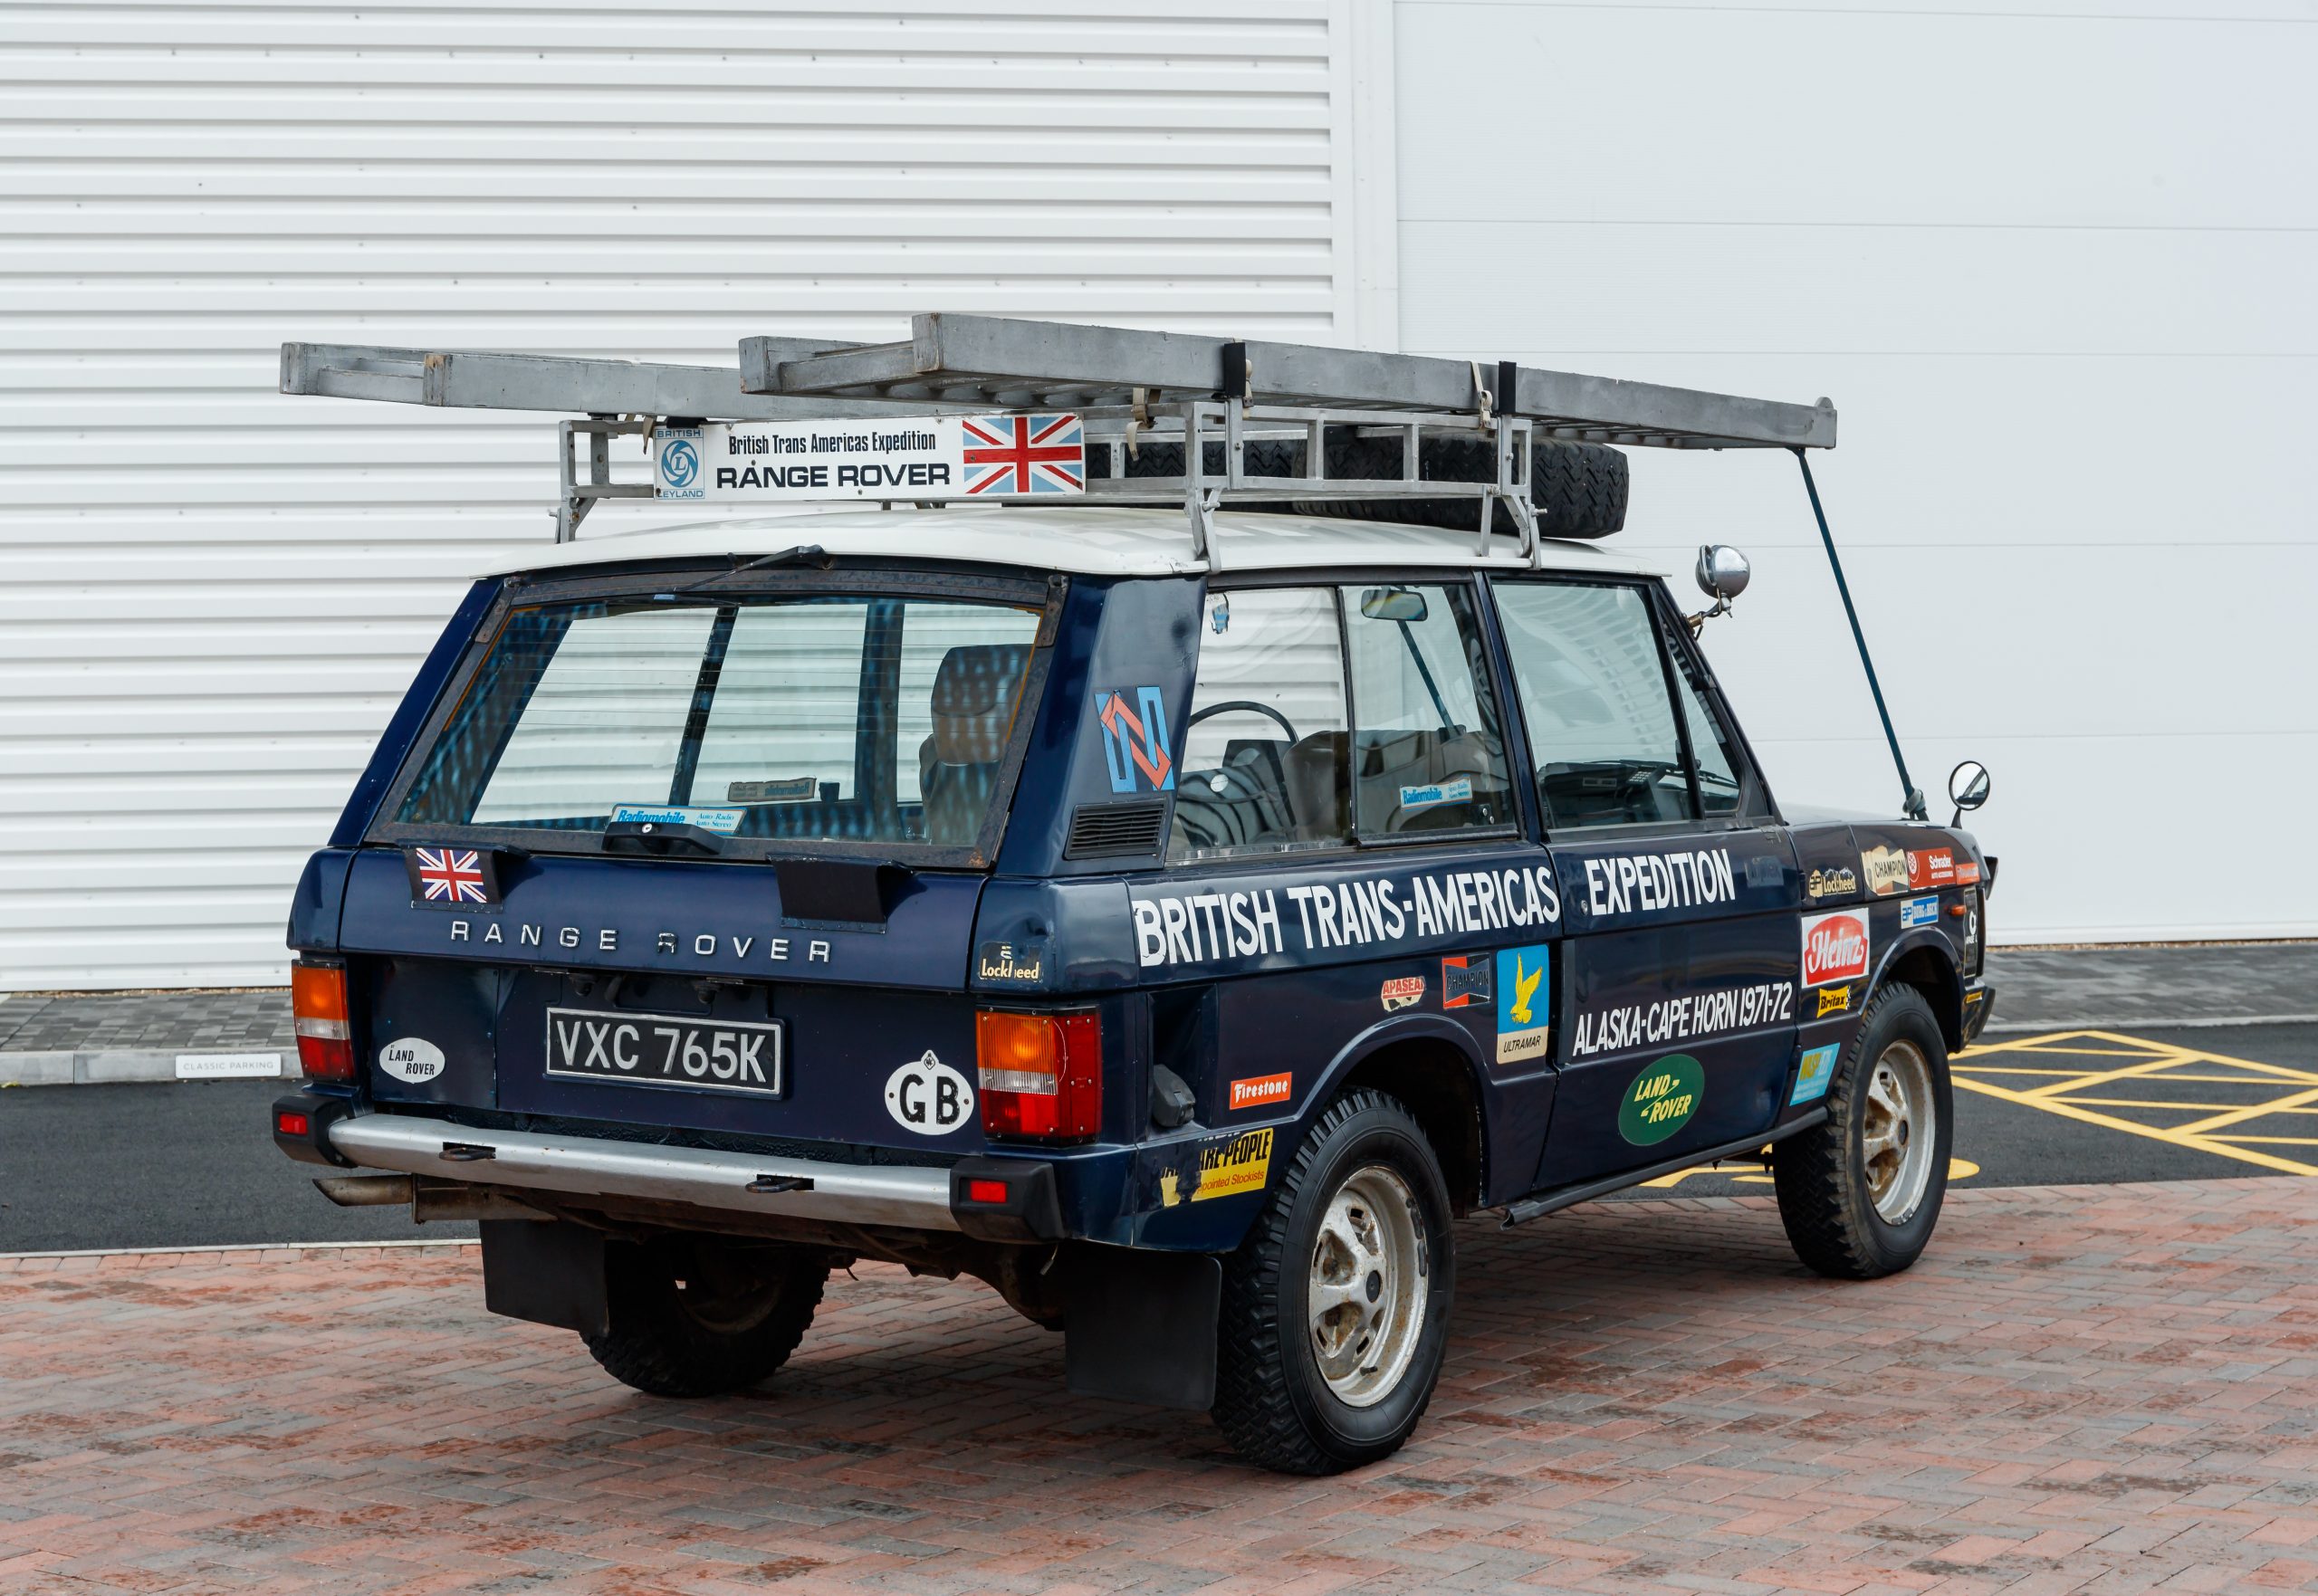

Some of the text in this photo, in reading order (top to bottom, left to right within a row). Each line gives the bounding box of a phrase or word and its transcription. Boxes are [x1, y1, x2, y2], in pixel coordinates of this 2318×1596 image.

[656, 429, 701, 438] BRITISH
[728, 429, 936, 455] British Trans Americas Expedition
[716, 463, 951, 489] RANGE ROVER
[1403, 788, 1442, 805] Radiomobile
[618, 809, 685, 824] Radiomobile
[1874, 859, 1907, 878] CHAMPION
[1584, 848, 1736, 917] EXPEDITION
[1130, 889, 1284, 968] BRITISH
[450, 920, 831, 963] RANGE ROVER
[1807, 927, 1864, 974] Heinz
[1446, 970, 1489, 991] CHAMPION
[1691, 989, 1737, 1034] HORN
[1738, 981, 1793, 1027] 1971-72
[1820, 994, 1845, 1010] Britax
[388, 1049, 415, 1062] LAND
[556, 1018, 766, 1084] VXC 765K
[1503, 1035, 1541, 1054] ULTRAMAR
[183, 1061, 273, 1071] CLASSIC PARKING
[405, 1062, 436, 1075] ROVER
[898, 1073, 961, 1125] GB
[1233, 1078, 1289, 1102] Firestone
[1222, 1131, 1271, 1168] PEOPLE
[1231, 1171, 1265, 1186] Stockists
